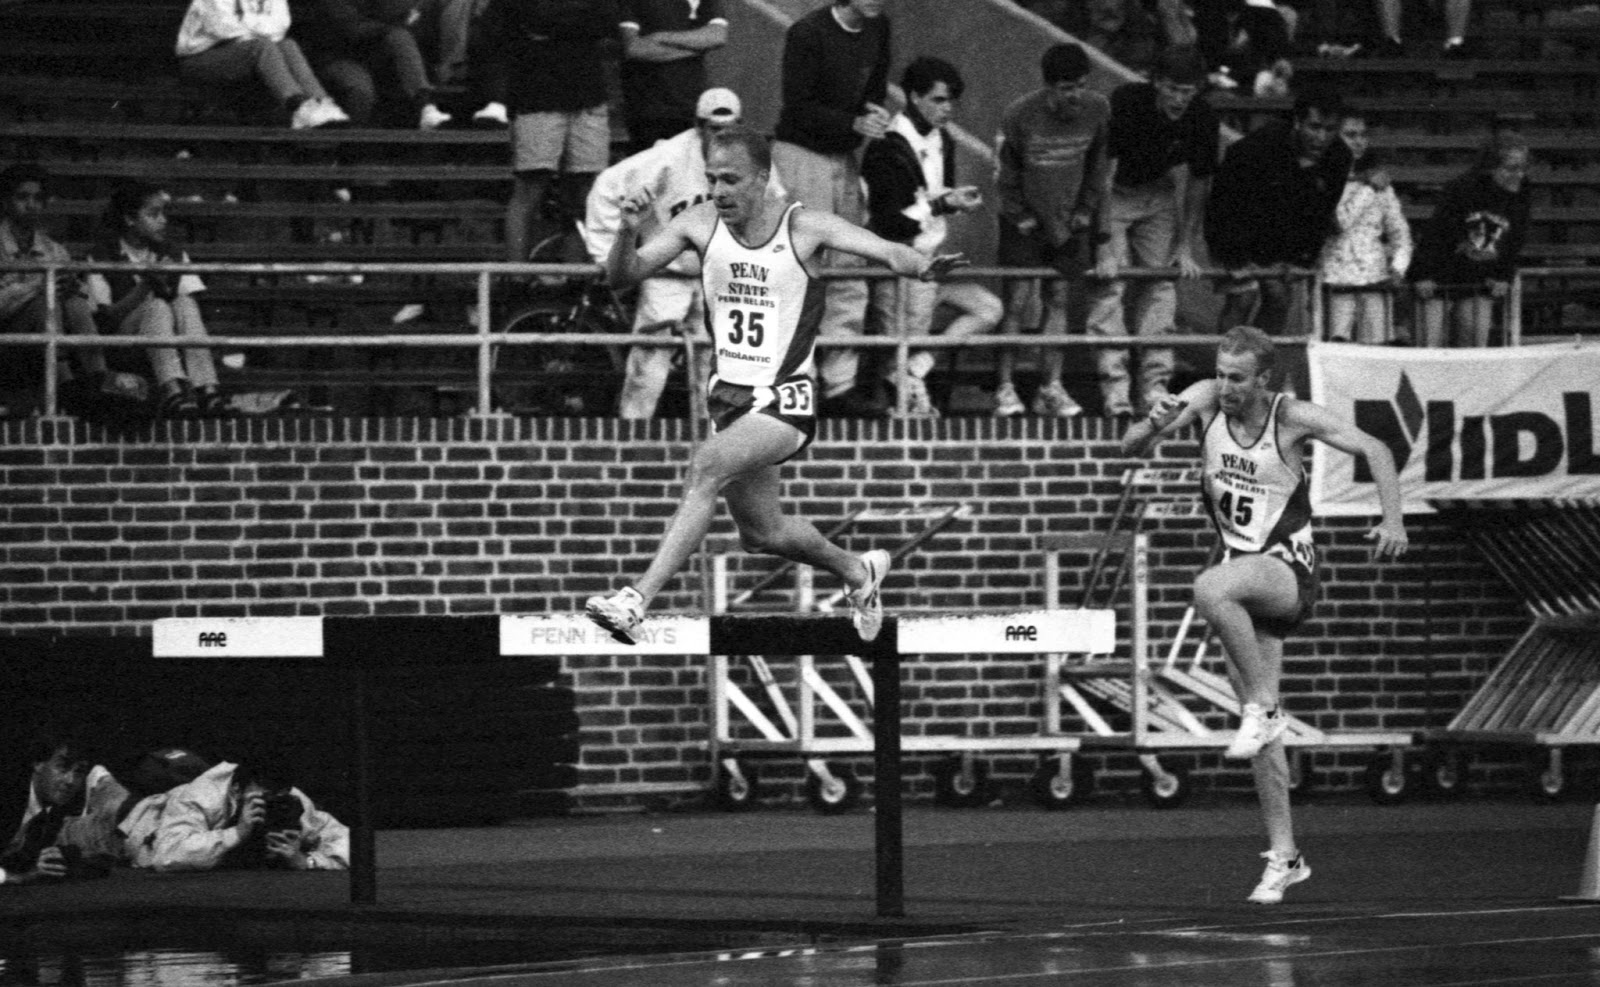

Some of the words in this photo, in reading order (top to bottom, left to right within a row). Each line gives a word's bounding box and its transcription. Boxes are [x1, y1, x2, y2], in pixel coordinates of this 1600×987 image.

[729, 262, 770, 283] PENN
[728, 282, 769, 297] STATE
[718, 295, 741, 304] PENN
[743, 297, 775, 308] RELAYS
[728, 309, 765, 348] 35
[781, 383, 810, 411] 35
[1221, 453, 1258, 476] PENN
[1219, 490, 1254, 527] 45
[531, 626, 586, 645] PENN
[594, 626, 677, 645] RAYS
